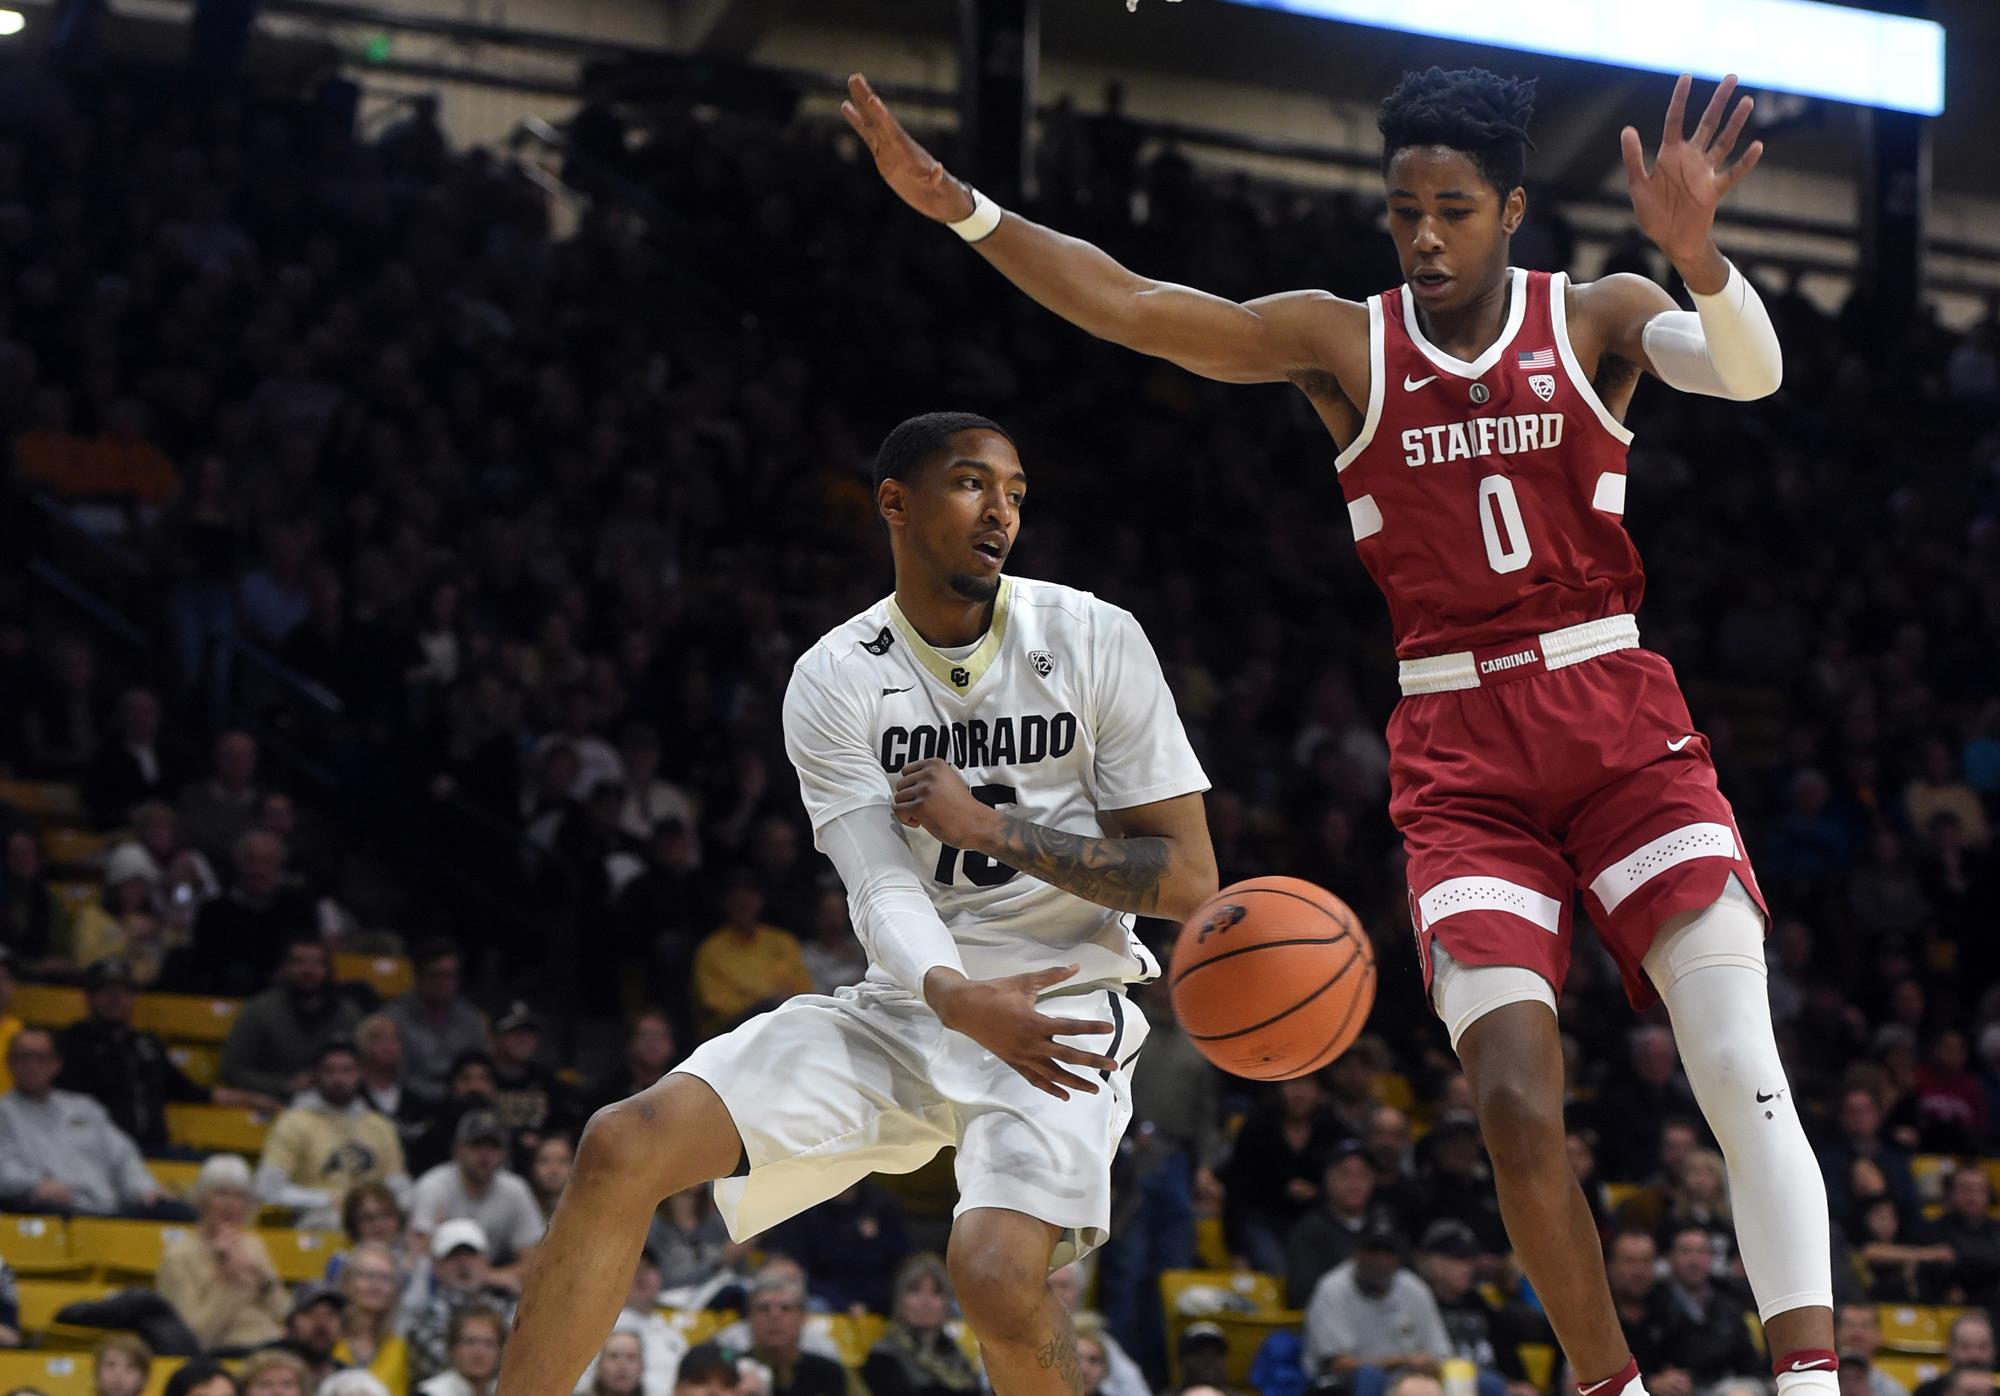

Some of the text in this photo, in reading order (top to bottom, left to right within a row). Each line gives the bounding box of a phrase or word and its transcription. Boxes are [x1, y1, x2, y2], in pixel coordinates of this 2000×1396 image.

[1479, 474, 1533, 574] 0
[1038, 661, 1050, 671] 12
[1480, 650, 1539, 674] CARDINAL
